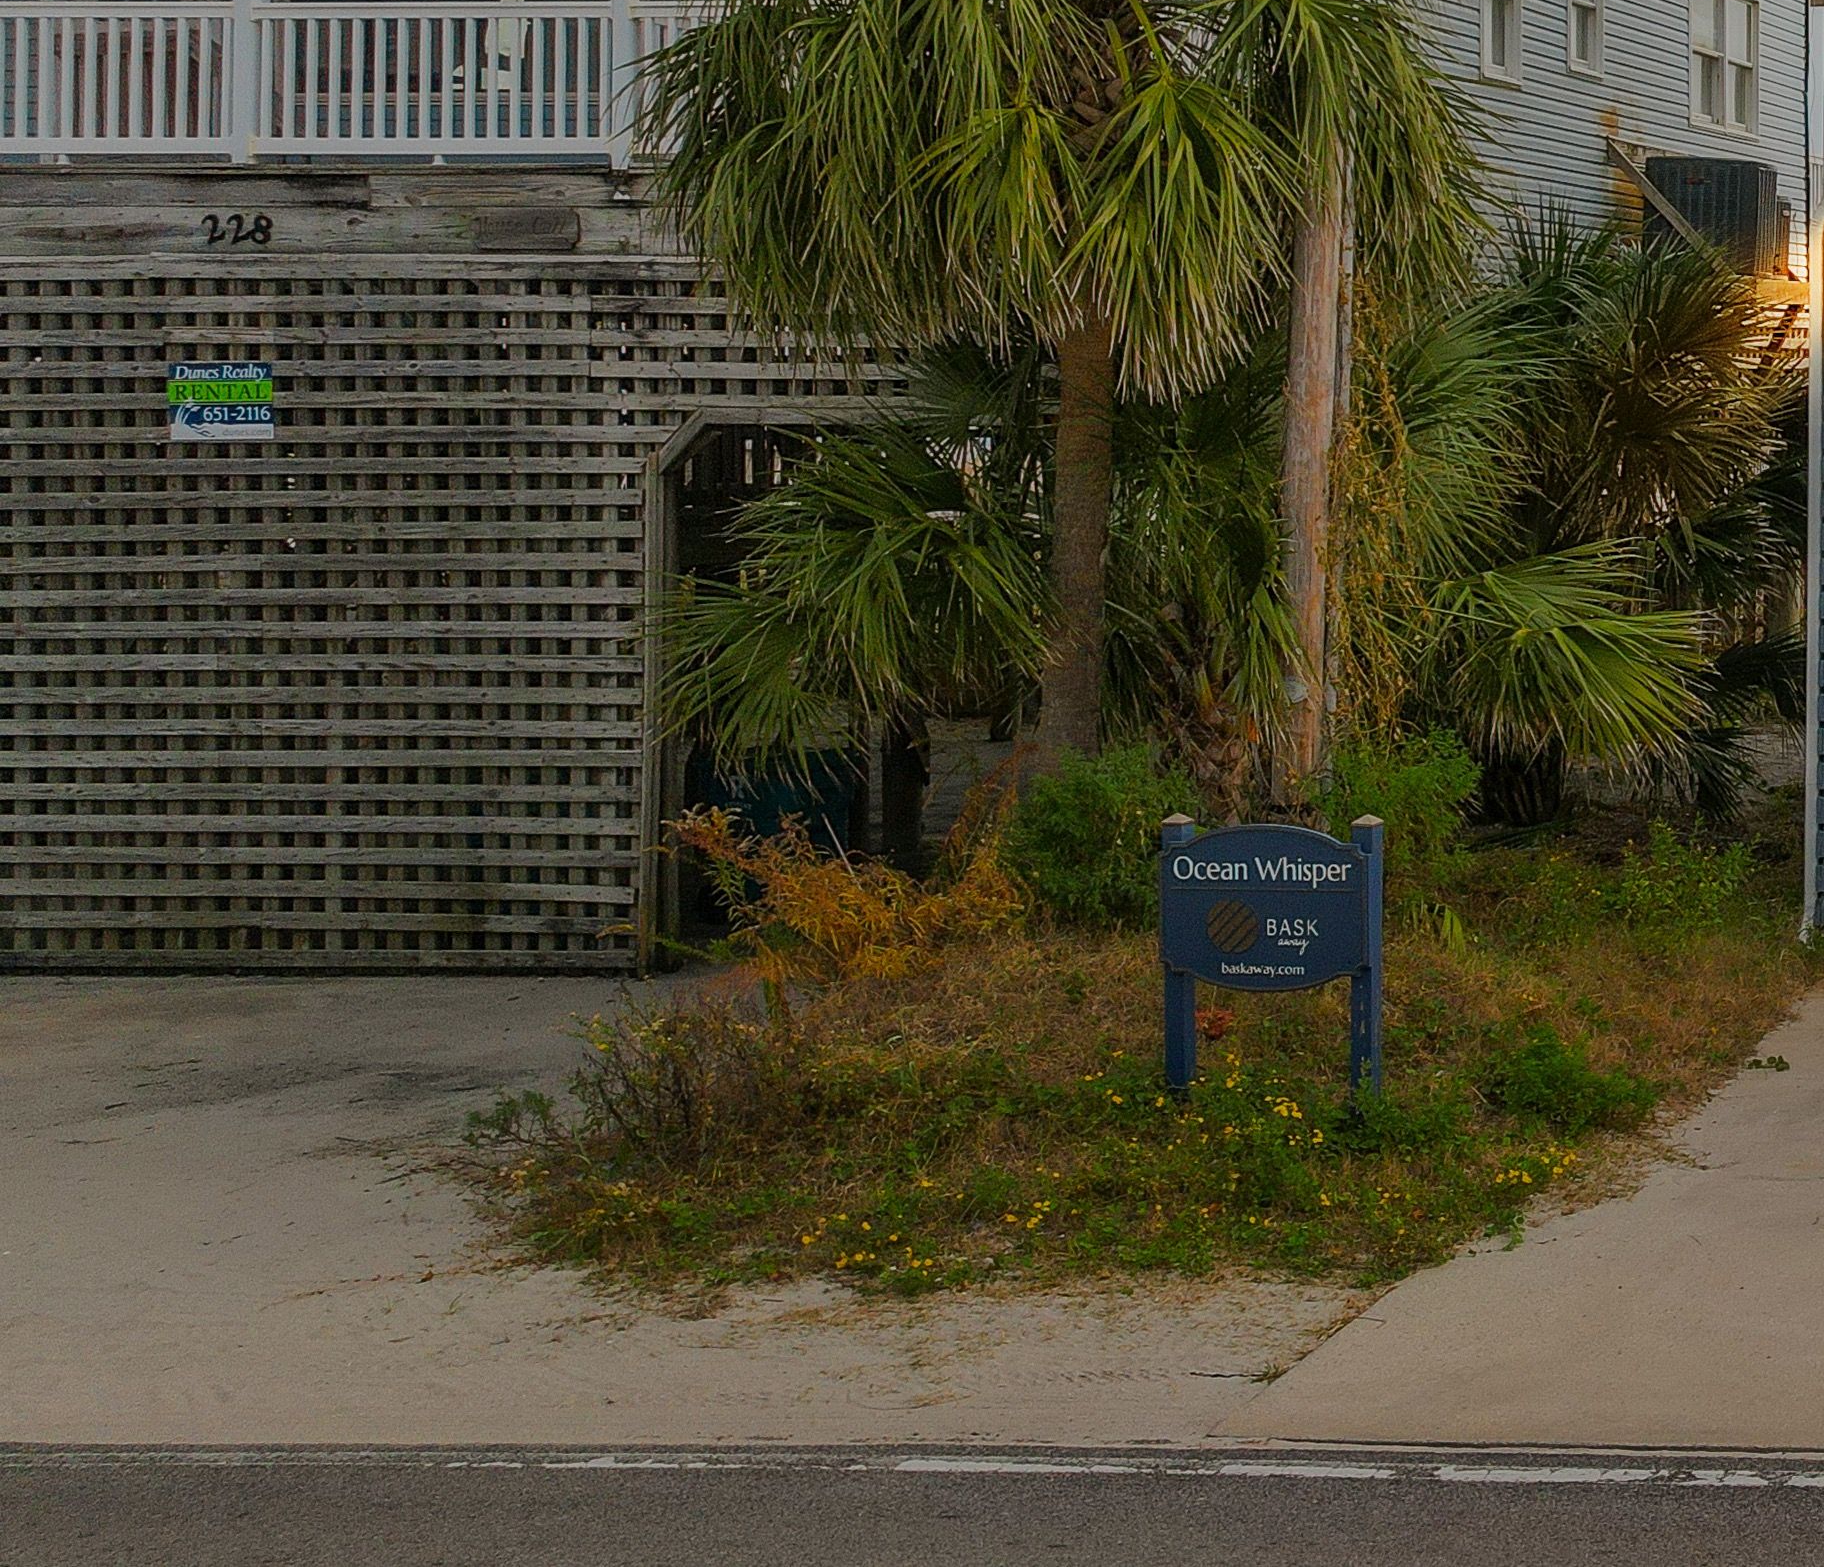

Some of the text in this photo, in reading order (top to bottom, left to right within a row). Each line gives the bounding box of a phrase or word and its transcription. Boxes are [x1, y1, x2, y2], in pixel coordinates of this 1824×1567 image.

[201, 214, 273, 244] 228
[175, 364, 267, 382] Dunes Realty
[174, 384, 267, 400] RENTAL
[203, 406, 271, 421] 651-2116
[1173, 855, 1351, 889] Ocean Whisper
[1266, 918, 1319, 936] BASK
[1278, 938, 1310, 956] away
[1221, 962, 1305, 977] baskaway.com
